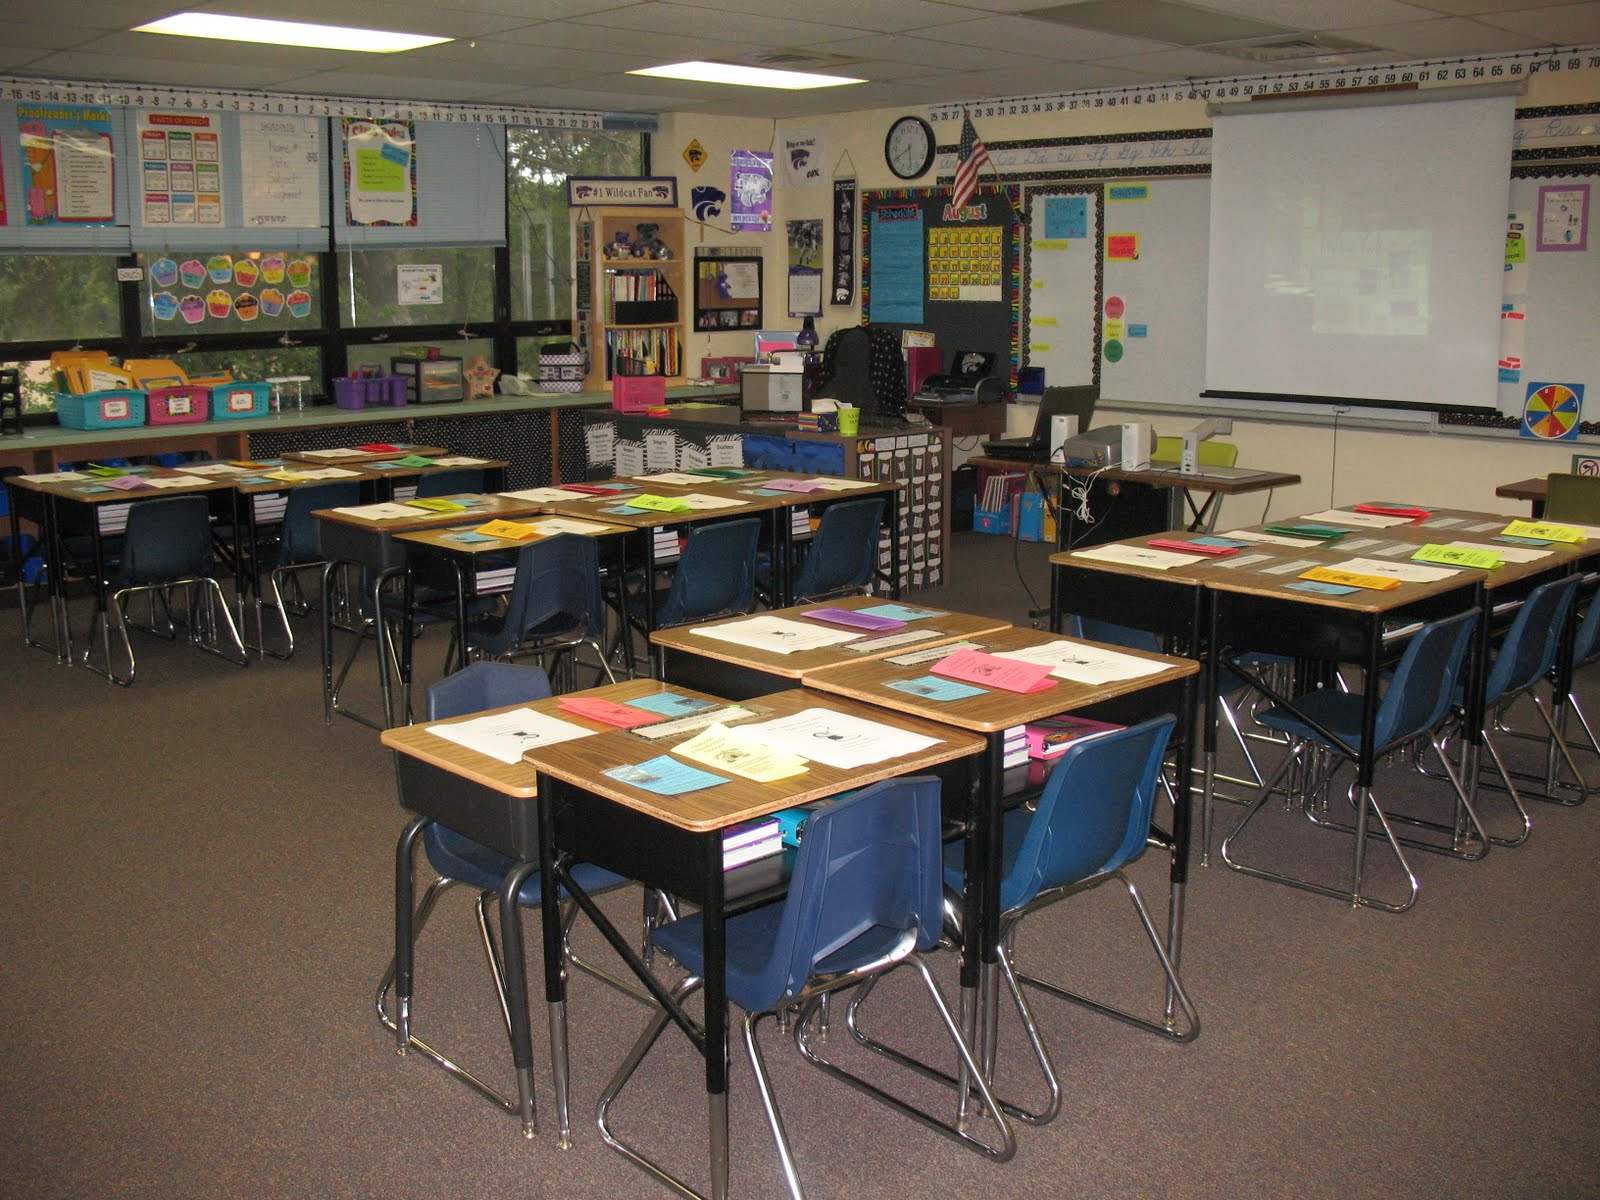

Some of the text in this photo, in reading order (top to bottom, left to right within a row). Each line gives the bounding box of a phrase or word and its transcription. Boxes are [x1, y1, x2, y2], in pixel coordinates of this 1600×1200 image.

[930, 113, 938, 121] 25
[942, 112, 948, 120] 26
[952, 111, 959, 119] 27
[974, 109, 982, 117] 29
[986, 108, 994, 116] 30
[998, 107, 1004, 116] 31
[1010, 106, 1016, 114] 32
[1021, 105, 1028, 114] 33
[1033, 104, 1040, 112] 34
[1045, 103, 1052, 112] 35
[1057, 102, 1065, 110] 36
[1070, 101, 1078, 110] 37
[1095, 98, 1103, 107] 39
[1108, 98, 1116, 106] 40
[1120, 96, 1128, 105] 41
[1134, 95, 1142, 104] 42
[1147, 94, 1156, 103] 43
[1174, 92, 1182, 100] 45
[1188, 90, 1196, 100] 46
[1216, 88, 1225, 98] 48
[1230, 87, 1238, 96] 49
[1244, 86, 1252, 95] 50
[1258, 84, 1267, 94] 51
[1273, 84, 1282, 92] 52
[1288, 82, 1298, 91] 53
[1304, 81, 1314, 90] 54
[1319, 80, 1330, 88] 55
[1336, 78, 1346, 88] 56
[1352, 77, 1362, 86] 57
[1368, 76, 1378, 85] 58
[1385, 74, 1396, 84] 59
[1402, 73, 1412, 82] 60
[1420, 72, 1430, 80] 61
[1438, 70, 1448, 80] 62
[1455, 68, 1466, 78] 63
[1473, 67, 1484, 77] 64
[1492, 66, 1502, 76] 65
[1510, 64, 1522, 74] 66
[1530, 62, 1540, 72] 67
[1549, 60, 1560, 72] 68
[1568, 58, 1580, 70] 69
[1588, 56, 1600, 68] 70
[26, 91, 40, 100] -15
[44, 91, 58, 100] -14
[64, 92, 76, 102] -13
[81, 94, 94, 104] -12
[136, 96, 144, 106] -9
[152, 97, 160, 106] -8
[168, 98, 176, 106] -7
[184, 98, 192, 108] -6
[200, 100, 208, 109] -5
[216, 100, 224, 110] -4
[232, 101, 240, 110] -3
[248, 102, 255, 111] -2
[262, 103, 270, 112] -1
[278, 104, 284, 112] 0
[294, 105, 298, 114] 1
[309, 106, 314, 114] 2
[324, 106, 330, 115] 3
[339, 108, 344, 116] 4
[353, 108, 358, 116] 5
[366, 108, 372, 117] 6
[380, 110, 386, 118] 7
[395, 110, 400, 118] 8
[408, 110, 412, 120] 9
[433, 112, 440, 121] 11
[446, 112, 454, 122] 12
[460, 113, 468, 122] 13
[473, 114, 480, 122] 14
[486, 114, 494, 123] 15
[499, 114, 507, 123] 16
[512, 115, 519, 124] 17
[524, 116, 531, 124] 18
[536, 116, 542, 126] 19
[547, 116, 554, 126] 20
[559, 118, 566, 127] 21
[570, 118, 578, 128] 22
[582, 119, 589, 128] 23
[592, 120, 600, 129] 24
[593, 187, 653, 198] #1 Wildcat Fan
[943, 204, 987, 222] August
